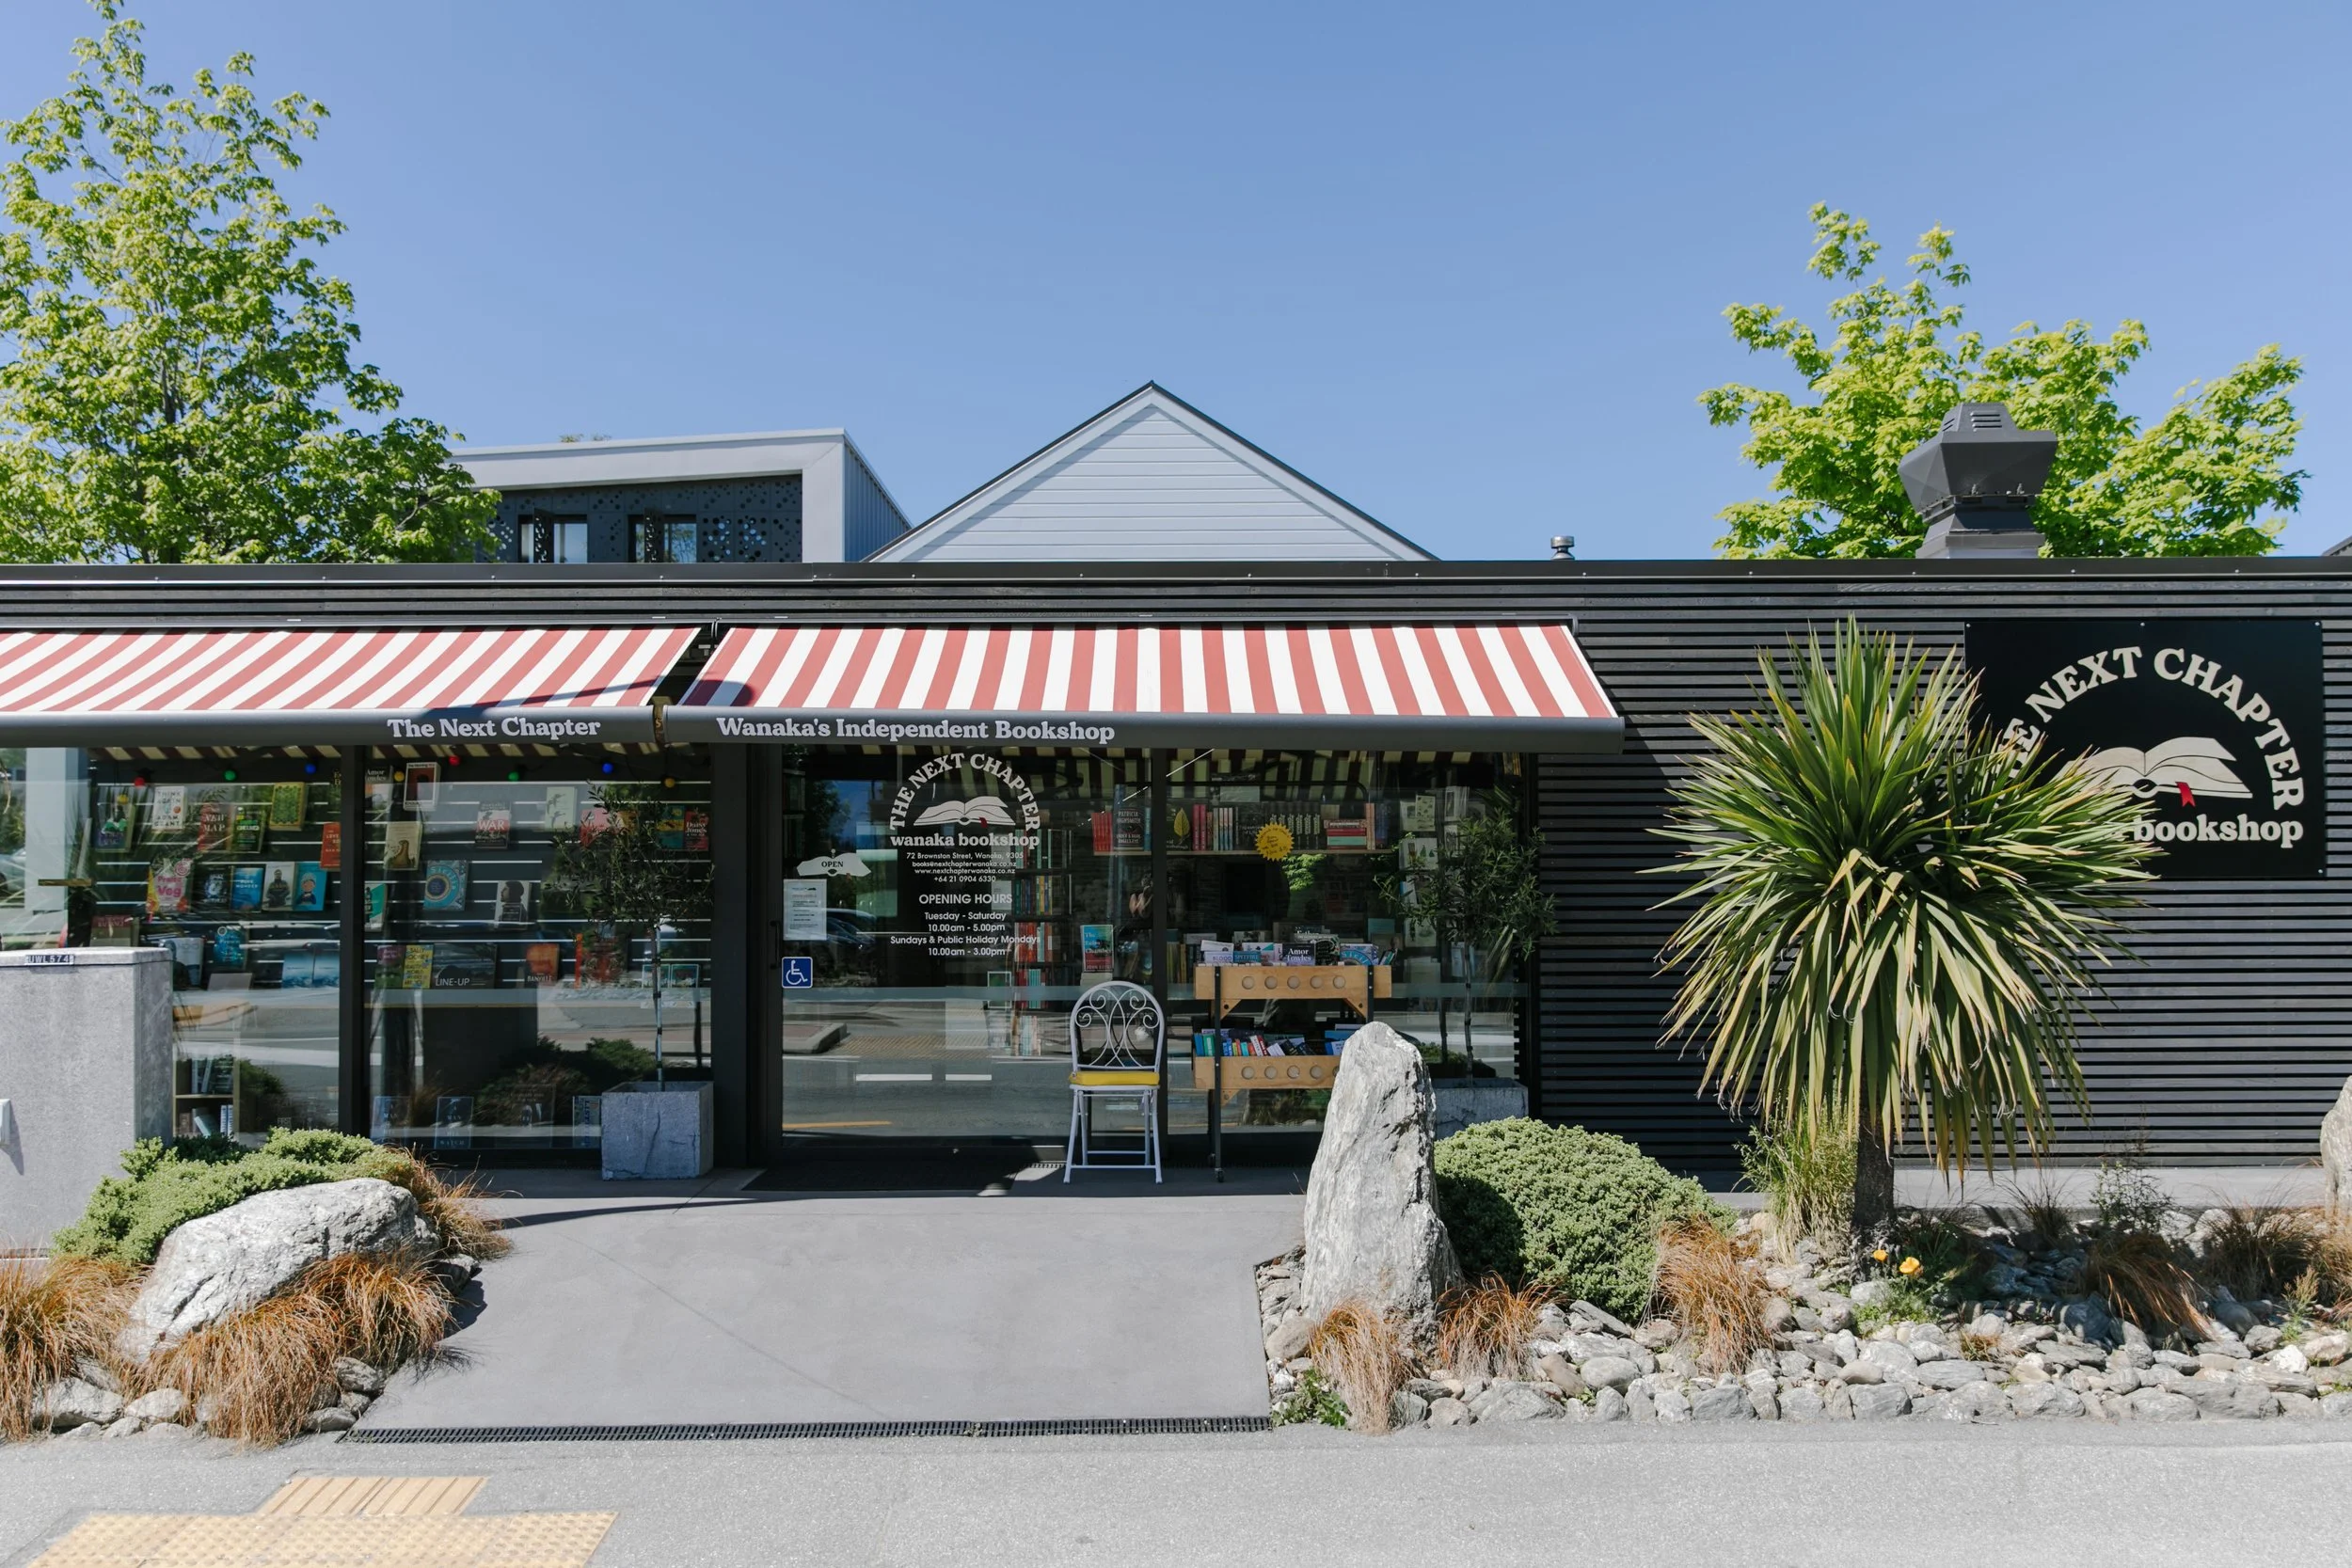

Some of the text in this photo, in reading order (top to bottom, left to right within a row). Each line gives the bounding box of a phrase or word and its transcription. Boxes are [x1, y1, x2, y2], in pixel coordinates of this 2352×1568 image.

[387, 717, 601, 740] The Next Chapter
[716, 718, 1115, 744] Wanaka's Independent Bookshop
[2025, 646, 2143, 724] NEXT
[2153, 648, 2305, 811] CHAPTER
[889, 752, 1041, 832] THE NEXT CHAPTER
[204, 823, 225, 832] MAP
[478, 819, 505, 832] WAR
[2133, 814, 2304, 848] bookshop
[890, 832, 1041, 849] wanaka bookshop
[906, 851, 915, 860] 72
[917, 851, 951, 860] Brownston
[952, 851, 973, 861] Street,
[1006, 851, 1024, 860] 9305
[158, 886, 182, 897] Veg
[918, 893, 1012, 905] OPENING HOURS
[924, 911, 961, 921] Tuesday
[967, 911, 1007, 921] Saturday
[928, 924, 965, 932] 10.00am
[973, 924, 1006, 933] 5.00pm
[890, 935, 928, 944] Sundays
[937, 935, 964, 943] Public
[965, 935, 999, 944] Holiday
[1000, 935, 1041, 945] Mondays
[928, 946, 965, 956] 10.00am
[973, 946, 1006, 957] 3.00pm
[435, 977, 470, 987] LINE-UP
